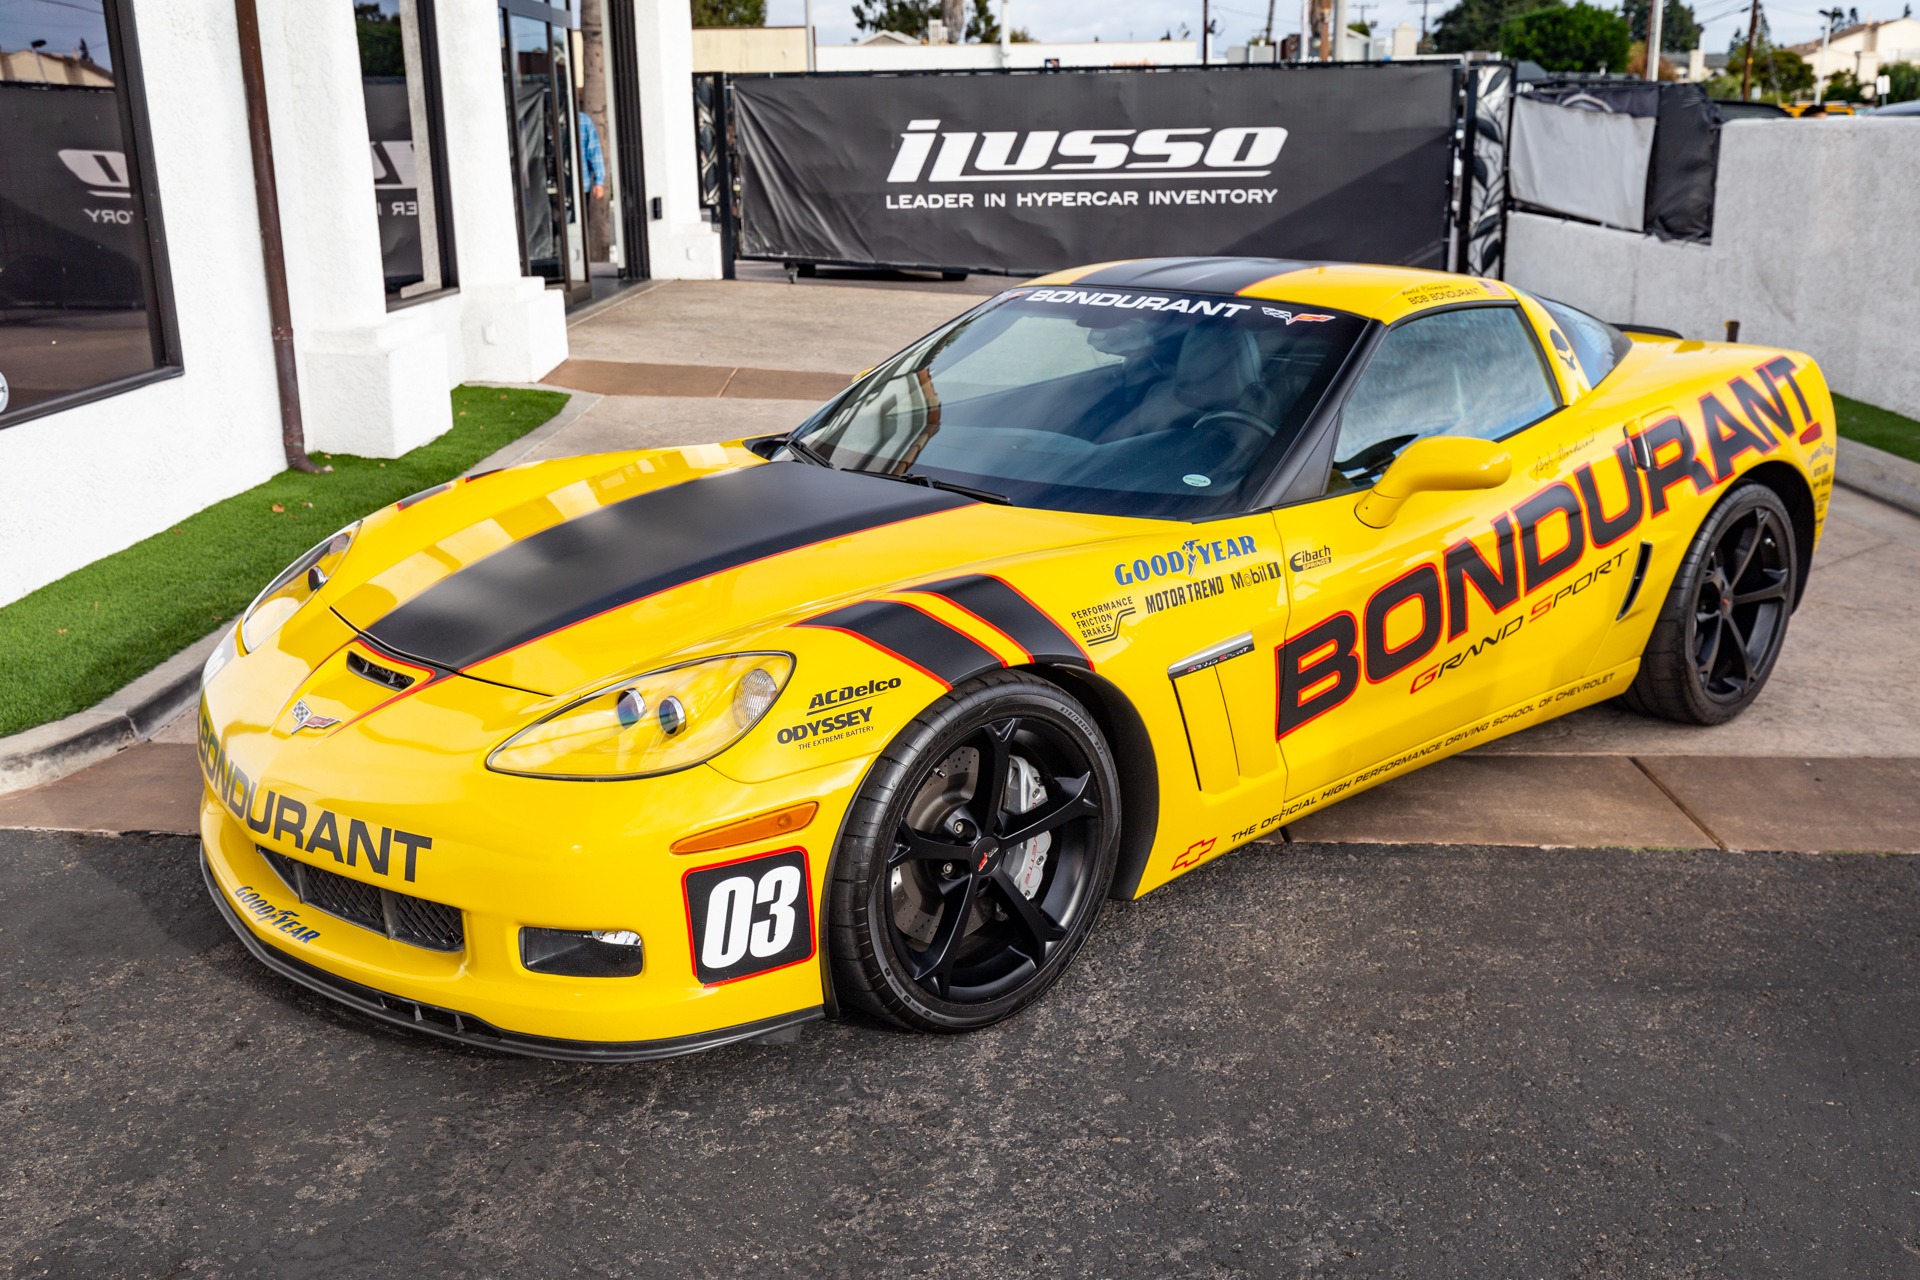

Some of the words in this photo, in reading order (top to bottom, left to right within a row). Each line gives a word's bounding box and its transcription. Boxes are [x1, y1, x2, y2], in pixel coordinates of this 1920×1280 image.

[886, 193, 974, 210] LEADER
[984, 192, 1006, 208] IN
[1016, 190, 1139, 208] HYPERCAR
[1148, 188, 1278, 206] INVENTORY
[1025, 289, 1252, 318] BONDURANT
[1408, 295, 1430, 305] BOB
[1430, 287, 1480, 301] BONDURANT
[1274, 355, 1813, 742] BONDURANT
[1289, 545, 1331, 572] Eibach
[1230, 565, 1268, 590] Mobil
[1302, 557, 1332, 571] SPRINGS
[1071, 596, 1134, 620] PERFORMANCE
[1144, 586, 1187, 614] MOTOR
[1186, 576, 1225, 603] TREND
[1076, 612, 1113, 630] FRICTION
[1081, 623, 1112, 638] BRAKES
[1409, 615, 1525, 694] GRAND
[1529, 548, 1630, 623] SPORT
[808, 677, 902, 710] ACDelco
[777, 706, 873, 744] ODYSSEY
[798, 742, 812, 750] THE
[813, 733, 844, 747] EXTREME
[846, 726, 874, 738] BATTERY
[1231, 823, 1258, 842] THE
[1261, 796, 1317, 828] OFFICIAL
[1321, 780, 1352, 800] HIGH
[1354, 742, 1443, 785] PERFORMANCE
[1445, 722, 1490, 747] DRIVING
[1492, 704, 1535, 727] SCHOOL
[1538, 695, 1553, 708] OF
[1555, 672, 1615, 702] CHEVROLET
[198, 715, 433, 883] BONDURANT
[701, 864, 801, 969] 03
